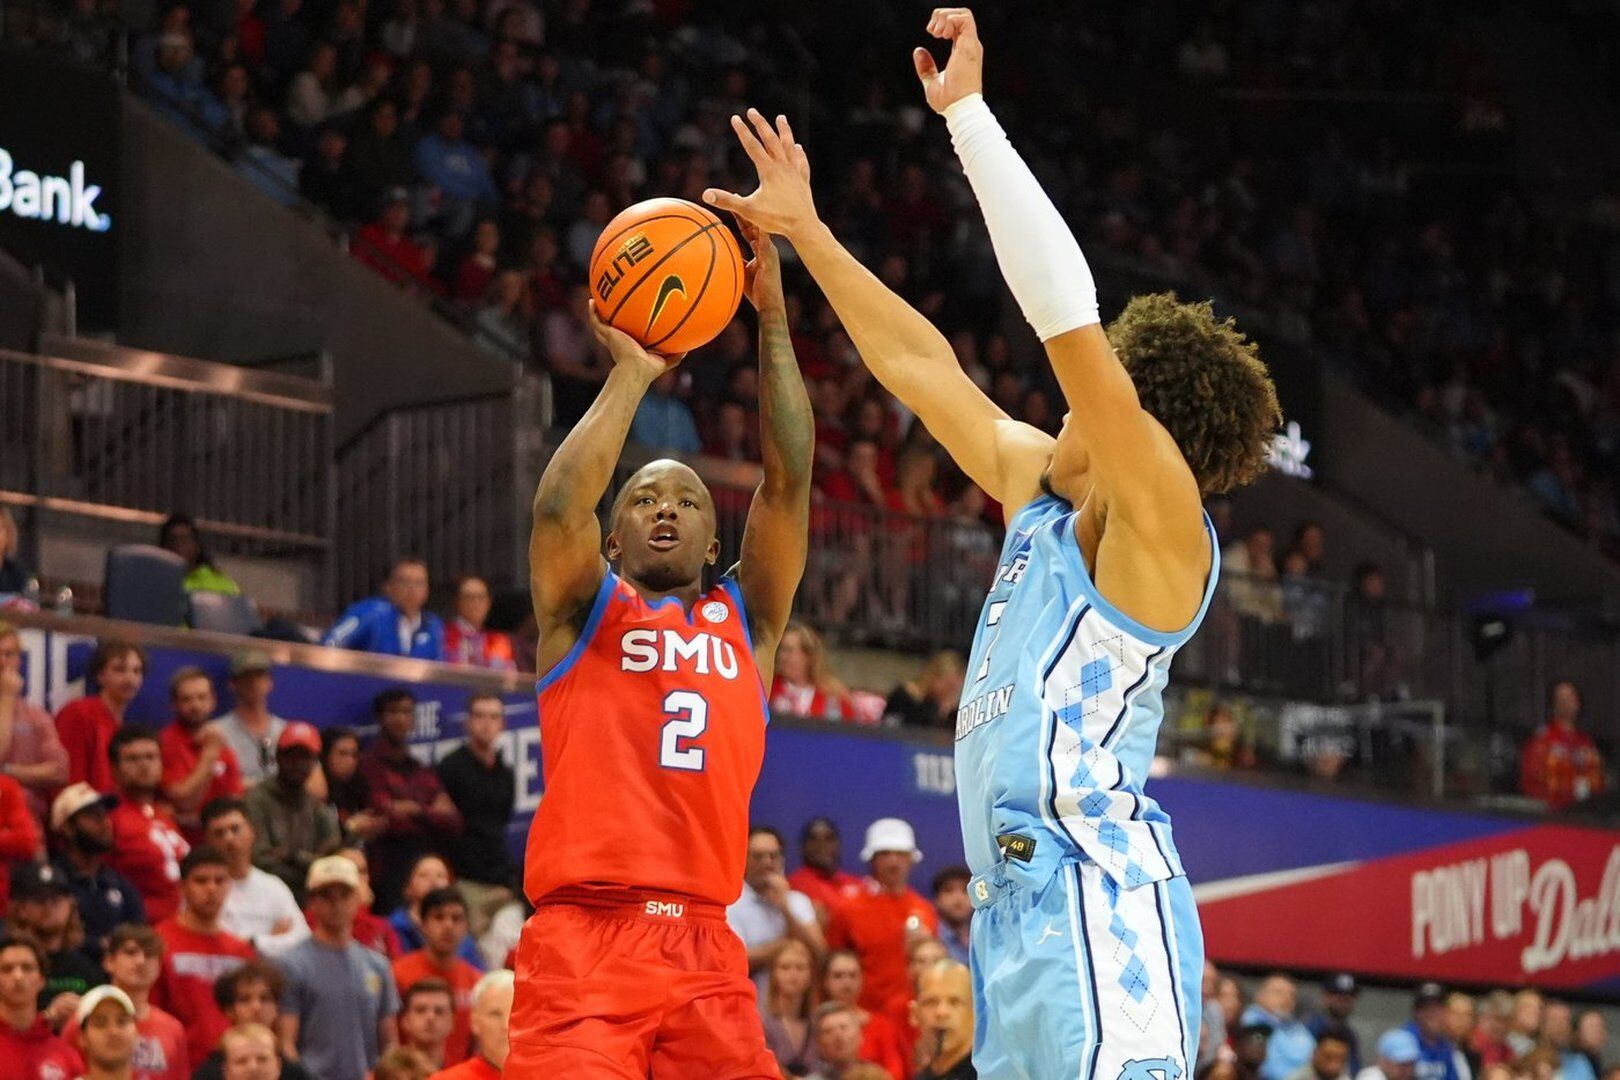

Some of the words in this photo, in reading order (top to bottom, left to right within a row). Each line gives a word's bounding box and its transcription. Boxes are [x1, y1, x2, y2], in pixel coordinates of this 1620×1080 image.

[597, 236, 654, 302] ELITE
[621, 629, 739, 680] SMU
[660, 690, 708, 772] 2
[955, 683, 1016, 742] AROLIN
[1010, 840, 1025, 852] 48
[645, 900, 684, 918] SMU
[1411, 857, 1488, 960] PONY
[1490, 848, 1531, 939] UP
